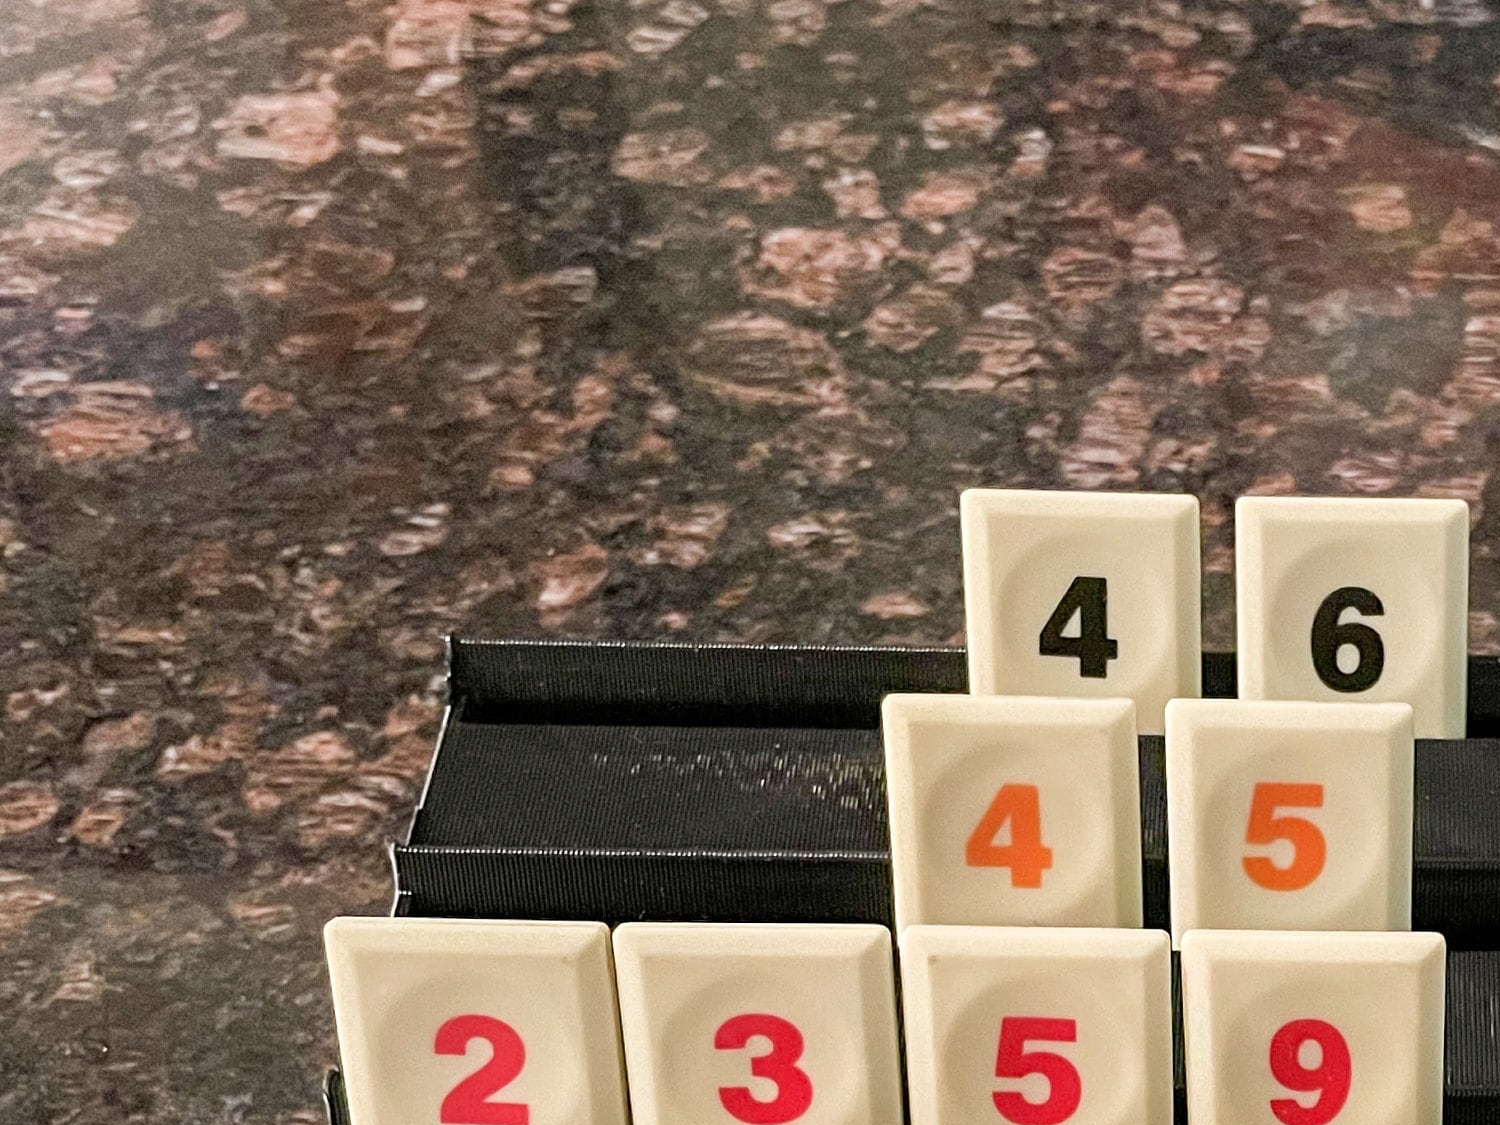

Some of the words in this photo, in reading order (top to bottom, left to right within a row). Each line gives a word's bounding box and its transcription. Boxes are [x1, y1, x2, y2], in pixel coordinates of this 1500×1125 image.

[1039, 576, 1118, 679] 4
[1311, 587, 1384, 693] 6
[966, 782, 1052, 887] 4
[1243, 783, 1325, 890] 5
[714, 1014, 812, 1125] 3
